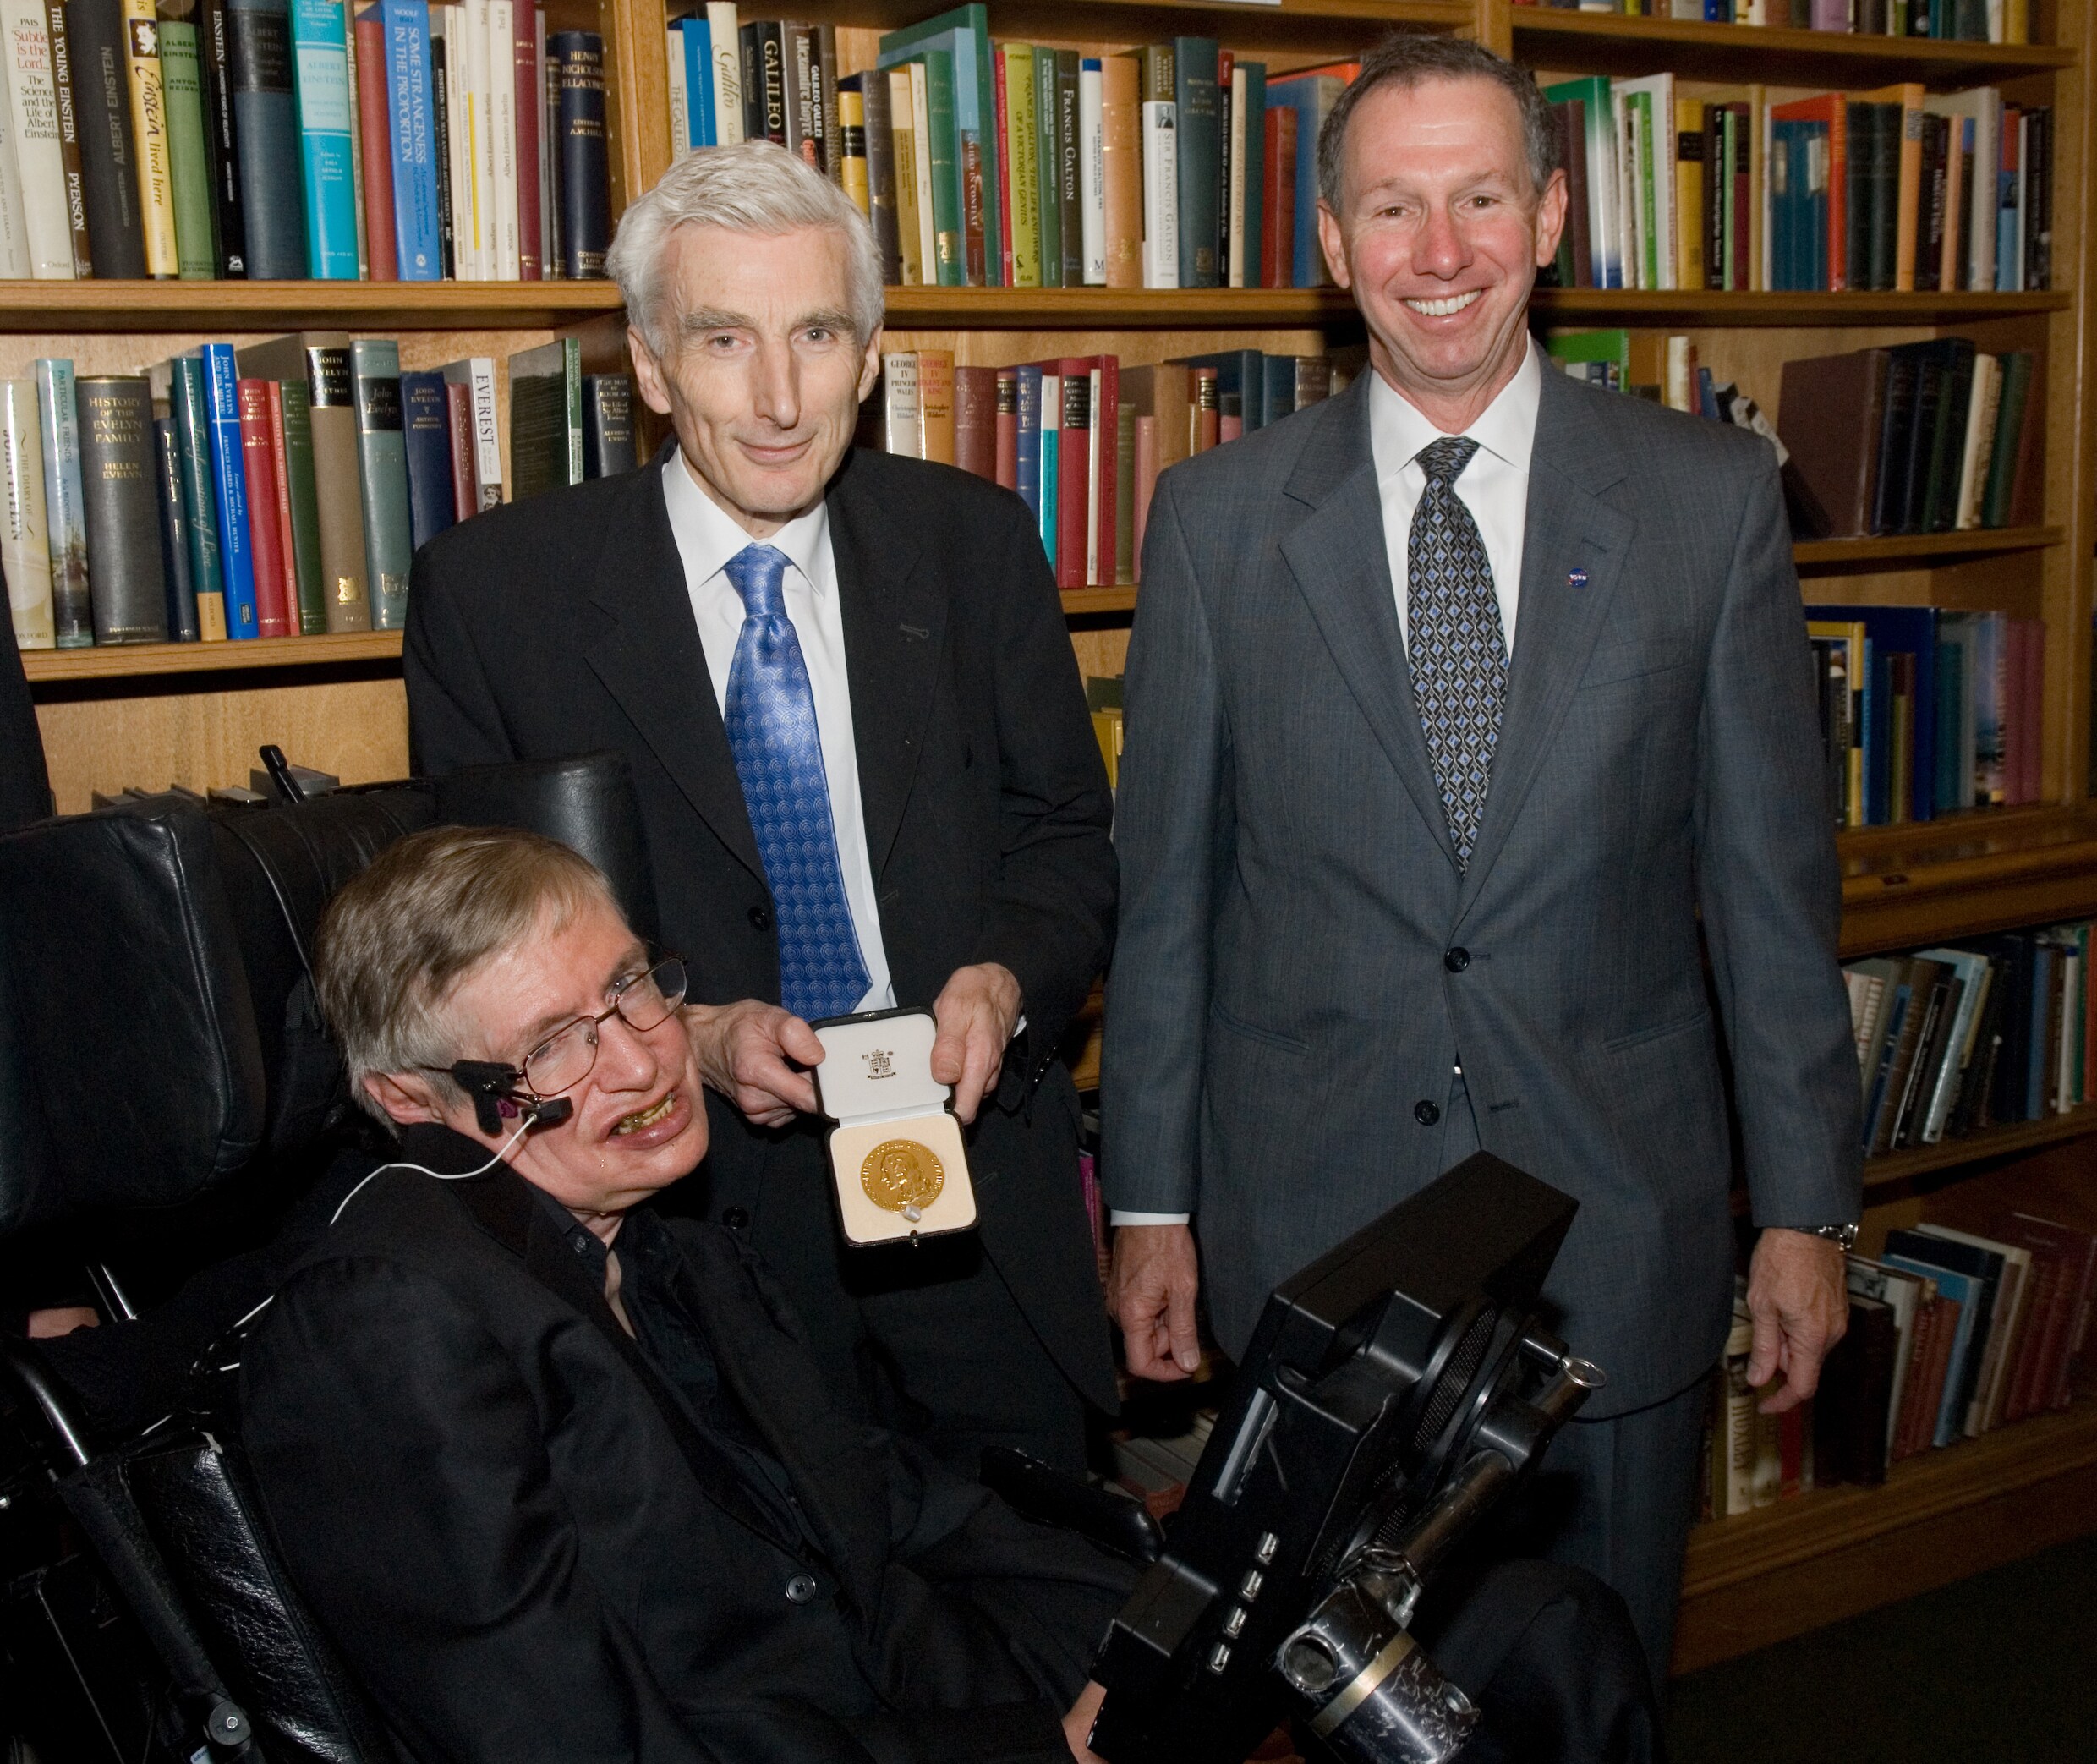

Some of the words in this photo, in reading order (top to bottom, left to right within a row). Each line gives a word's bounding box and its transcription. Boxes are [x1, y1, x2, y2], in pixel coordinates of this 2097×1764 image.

[51, 6, 63, 33] THE
[394, 8, 419, 17] WOOLF
[213, 10, 225, 62] EINSTEIN
[346, 31, 355, 62] Albert
[394, 27, 405, 42] IN
[408, 27, 421, 67] SOME
[17, 44, 26, 55] is
[30, 44, 47, 56] the
[54, 36, 68, 83] YOUNG
[396, 46, 408, 73] THE
[570, 51, 599, 63] HENRY
[28, 75, 44, 85] The
[101, 47, 118, 107] EINSTEIN
[307, 62, 342, 71] ALBERT
[712, 44, 741, 109] Galileo
[796, 35, 811, 99] Alexandre
[21, 86, 54, 96] Science
[303, 76, 345, 85] EINSTEIN
[348, 63, 357, 101] Einstein
[764, 41, 781, 129] GALILEO
[811, 65, 820, 102] GALILEO
[22, 97, 39, 107] and
[41, 97, 55, 107] the
[134, 65, 162, 136] Einstein
[671, 86, 680, 104] THE
[1024, 75, 1034, 119] FRANCIS
[26, 107, 42, 118] Life
[45, 108, 53, 118] of
[27, 118, 55, 128] Albert
[59, 86, 75, 143] EINSTEIN
[397, 76, 413, 162] PROPORTION
[410, 69, 427, 164] STRANGENESS
[813, 103, 823, 138] GALILEI
[1016, 111, 1022, 125] OF
[1064, 90, 1074, 144] FRANCIS
[1235, 115, 1244, 134] THE
[25, 128, 59, 139] Einstein
[110, 114, 125, 165] ALBERT
[673, 107, 684, 153] GALILEO
[1163, 133, 1173, 153] SIR
[149, 143, 162, 175] lived
[1017, 134, 1027, 186] VICTORIAN
[970, 172, 976, 183] IN
[1065, 147, 1076, 200] GALTON
[1164, 157, 1173, 207] FRANCIS
[68, 173, 85, 231] PYENSON
[154, 178, 164, 205] here
[1165, 213, 1174, 262] GALTON
[1235, 216, 1243, 236] MAN
[220, 355, 231, 380] JOHN
[312, 368, 348, 377] EVELYN
[890, 359, 916, 368] GEORGE
[921, 359, 948, 368] GEORGE
[58, 370, 69, 424] PARTICULAR
[89, 397, 142, 407] HISTORY
[224, 382, 233, 414] EVELYN
[371, 387, 393, 402] John
[366, 403, 399, 416] Evelyn
[475, 375, 495, 446] EVEREST
[93, 420, 143, 430] EVELYN
[63, 426, 72, 463] FRIENDS
[95, 434, 141, 444] FAMILY
[20, 453, 29, 472] THE
[102, 470, 143, 479] EVELYN
[22, 474, 31, 501] DIARY
[185, 423, 209, 518] Transformations
[202, 539, 216, 567] Love
[7, 480, 22, 541] EVELYN
[25, 504, 32, 516] OF
